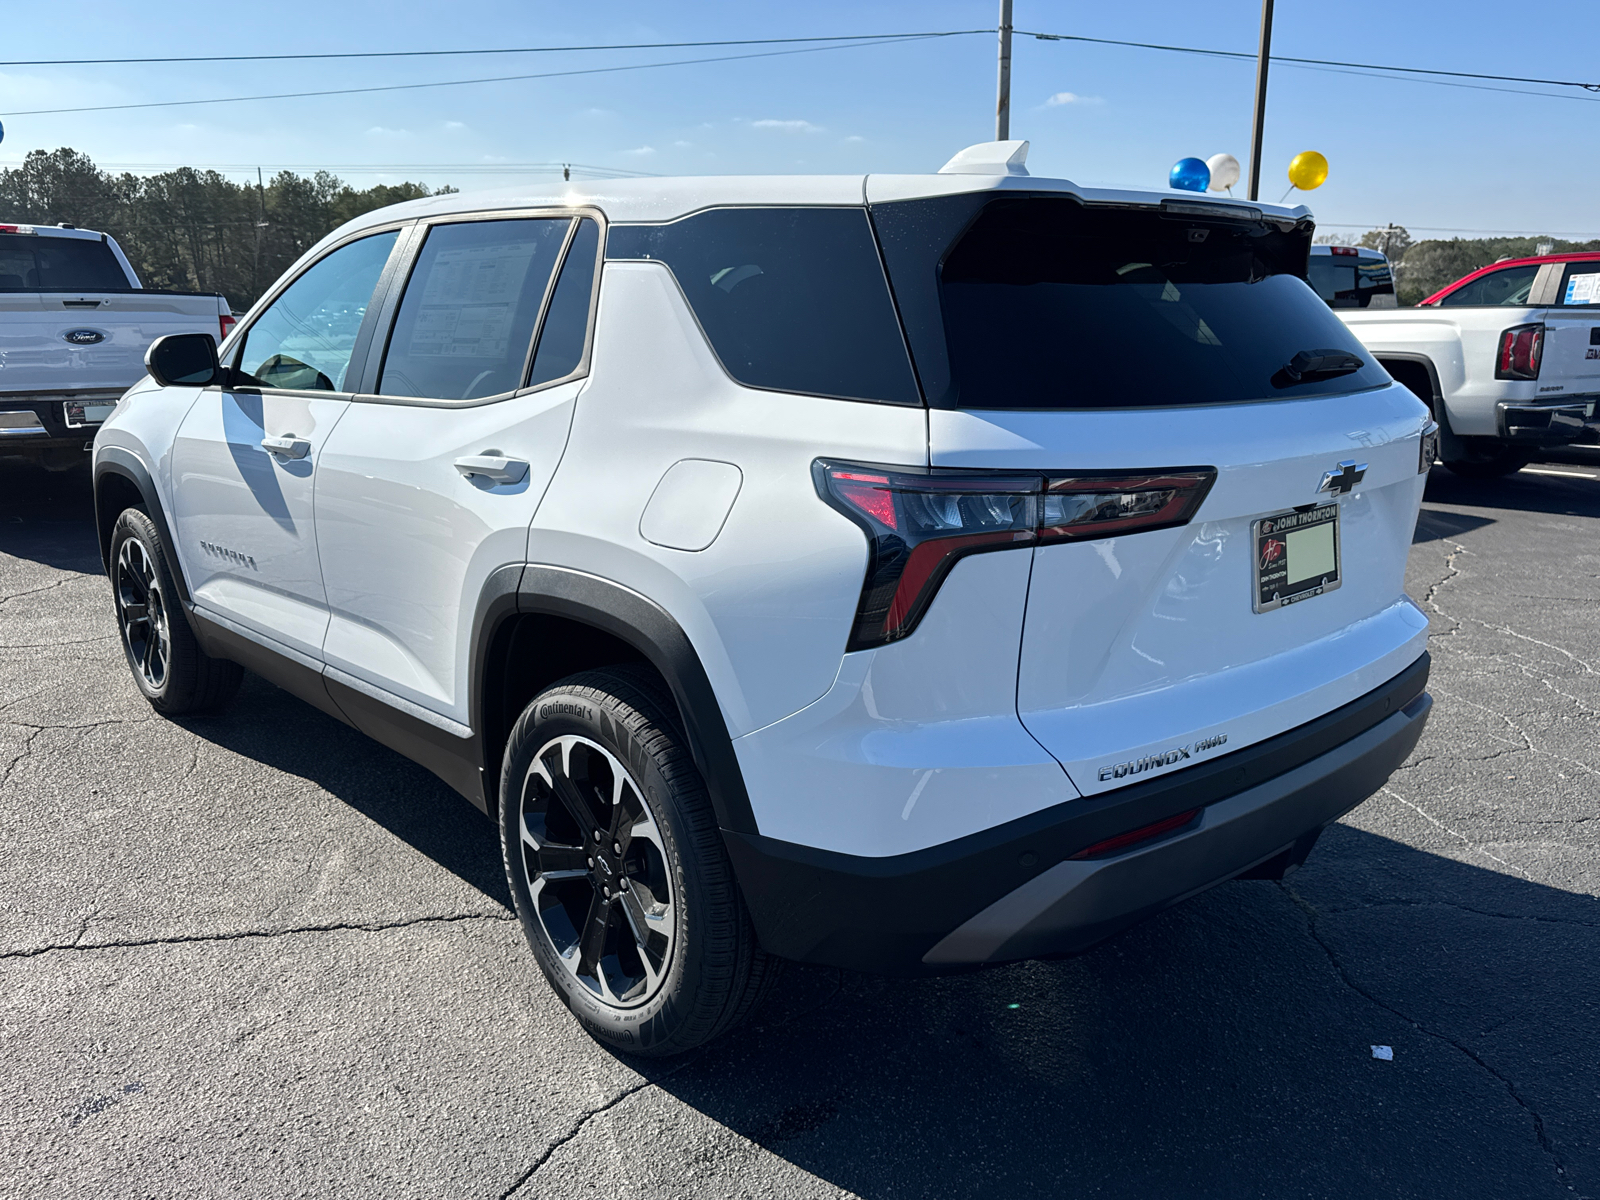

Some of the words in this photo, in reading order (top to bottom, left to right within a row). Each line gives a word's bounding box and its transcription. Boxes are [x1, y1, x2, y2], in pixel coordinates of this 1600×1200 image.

[1276, 516, 1297, 531] JOHN
[1299, 506, 1336, 524] THORNTON
[540, 700, 586, 720] Continental
[1098, 744, 1192, 782] EQUINOX
[1194, 733, 1228, 753] AWD
